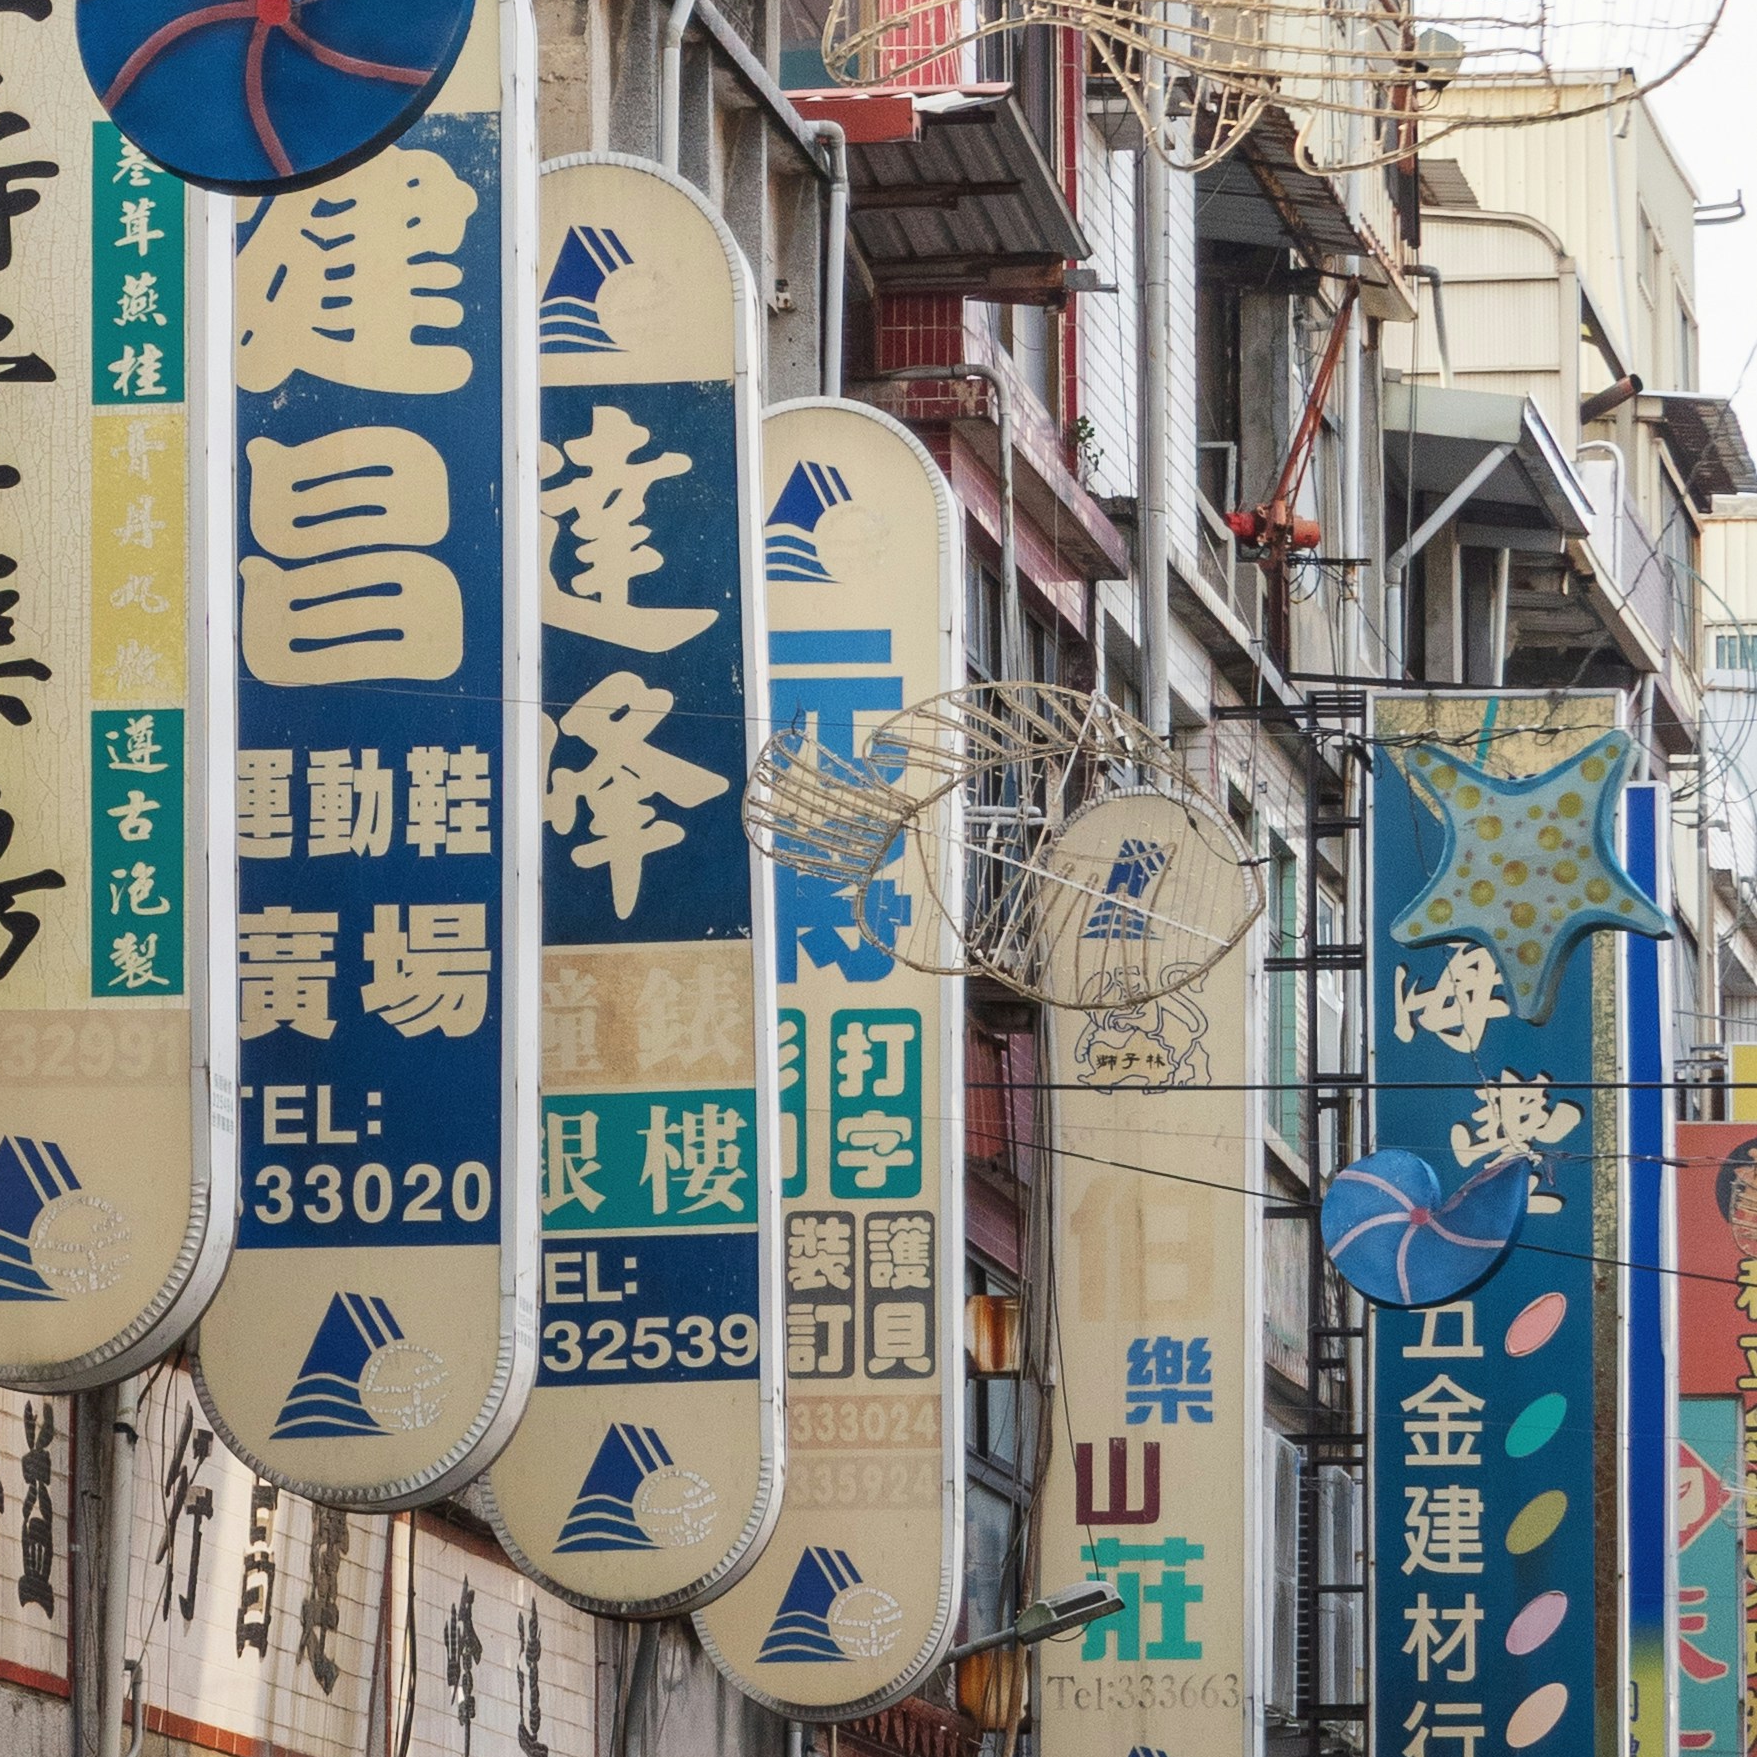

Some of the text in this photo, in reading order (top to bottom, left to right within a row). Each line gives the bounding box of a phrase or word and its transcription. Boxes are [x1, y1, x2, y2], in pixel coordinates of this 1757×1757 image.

[836, 1020, 915, 1189] 打字
[238, 1160, 493, 1225] 33020
[786, 1214, 853, 1375] 裝訂
[867, 1214, 933, 1375] 護貝
